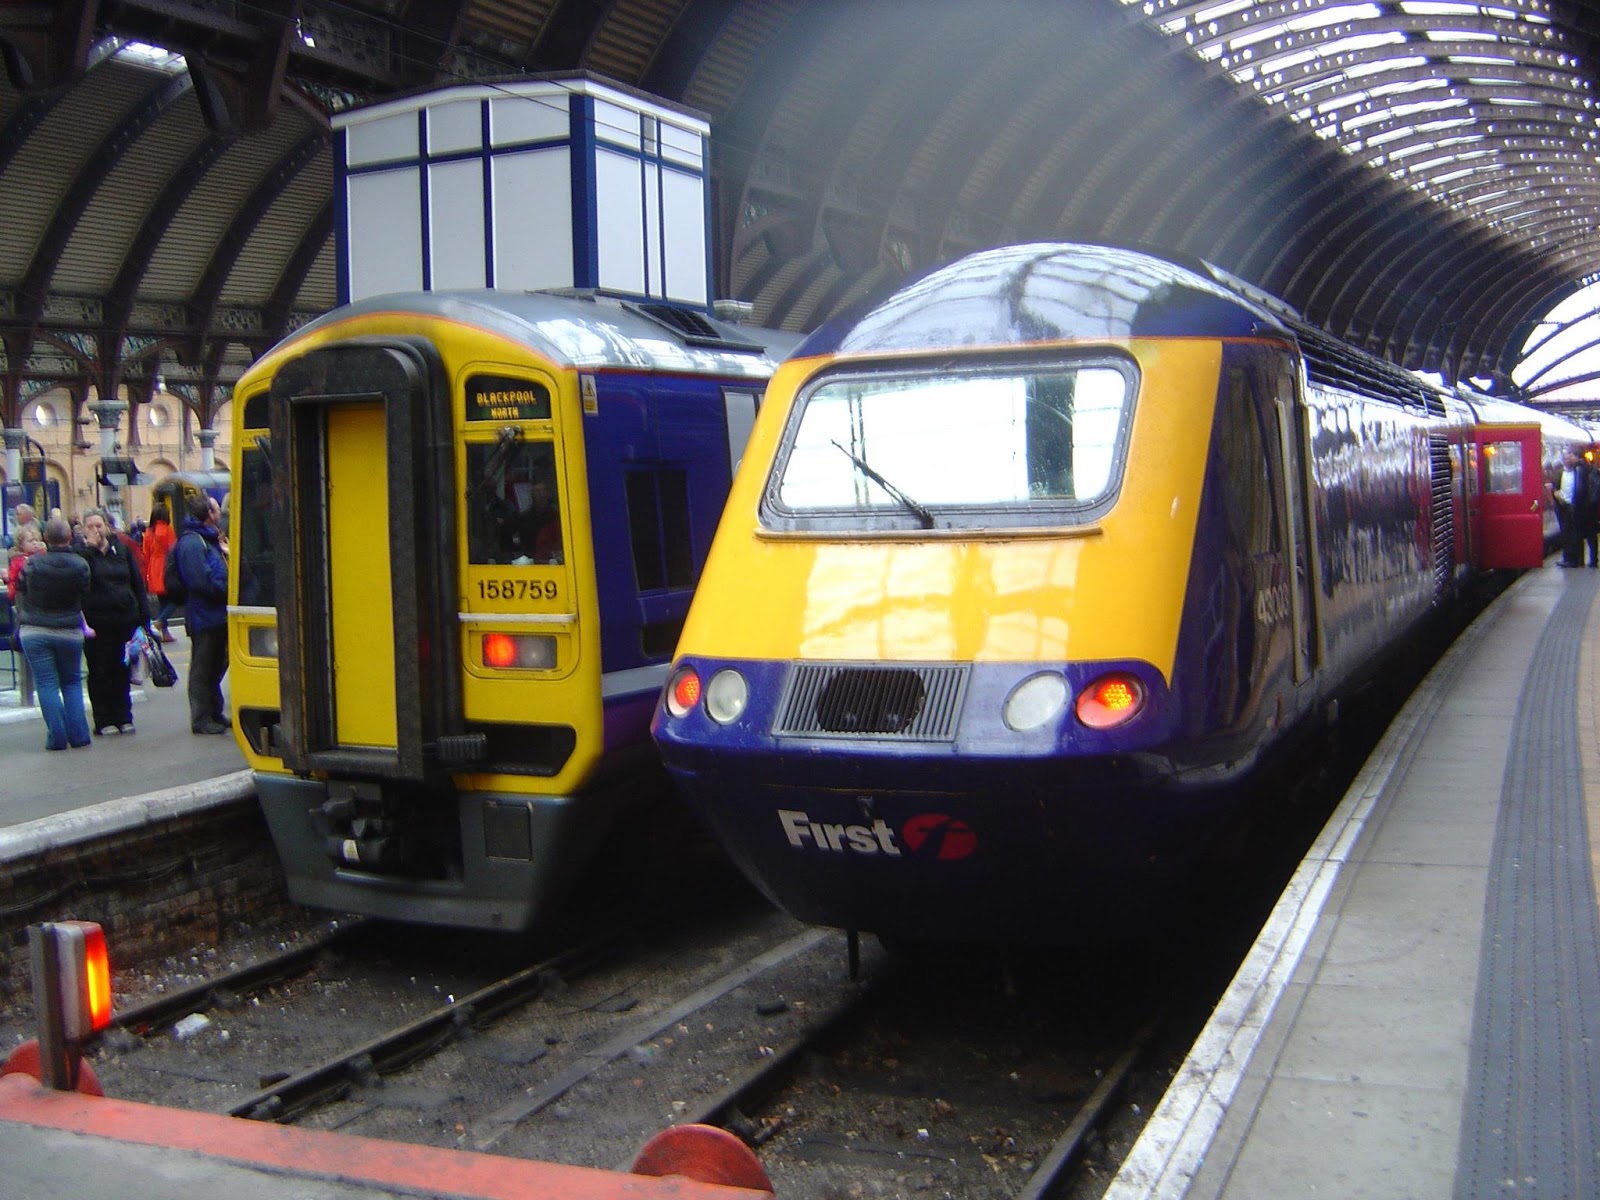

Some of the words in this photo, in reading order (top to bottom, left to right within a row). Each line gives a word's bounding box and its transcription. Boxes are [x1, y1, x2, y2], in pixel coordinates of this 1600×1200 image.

[476, 390, 537, 405] BLACKPOOL
[491, 406, 519, 419] NORTH
[478, 579, 557, 600] 158759
[777, 809, 901, 855] First
